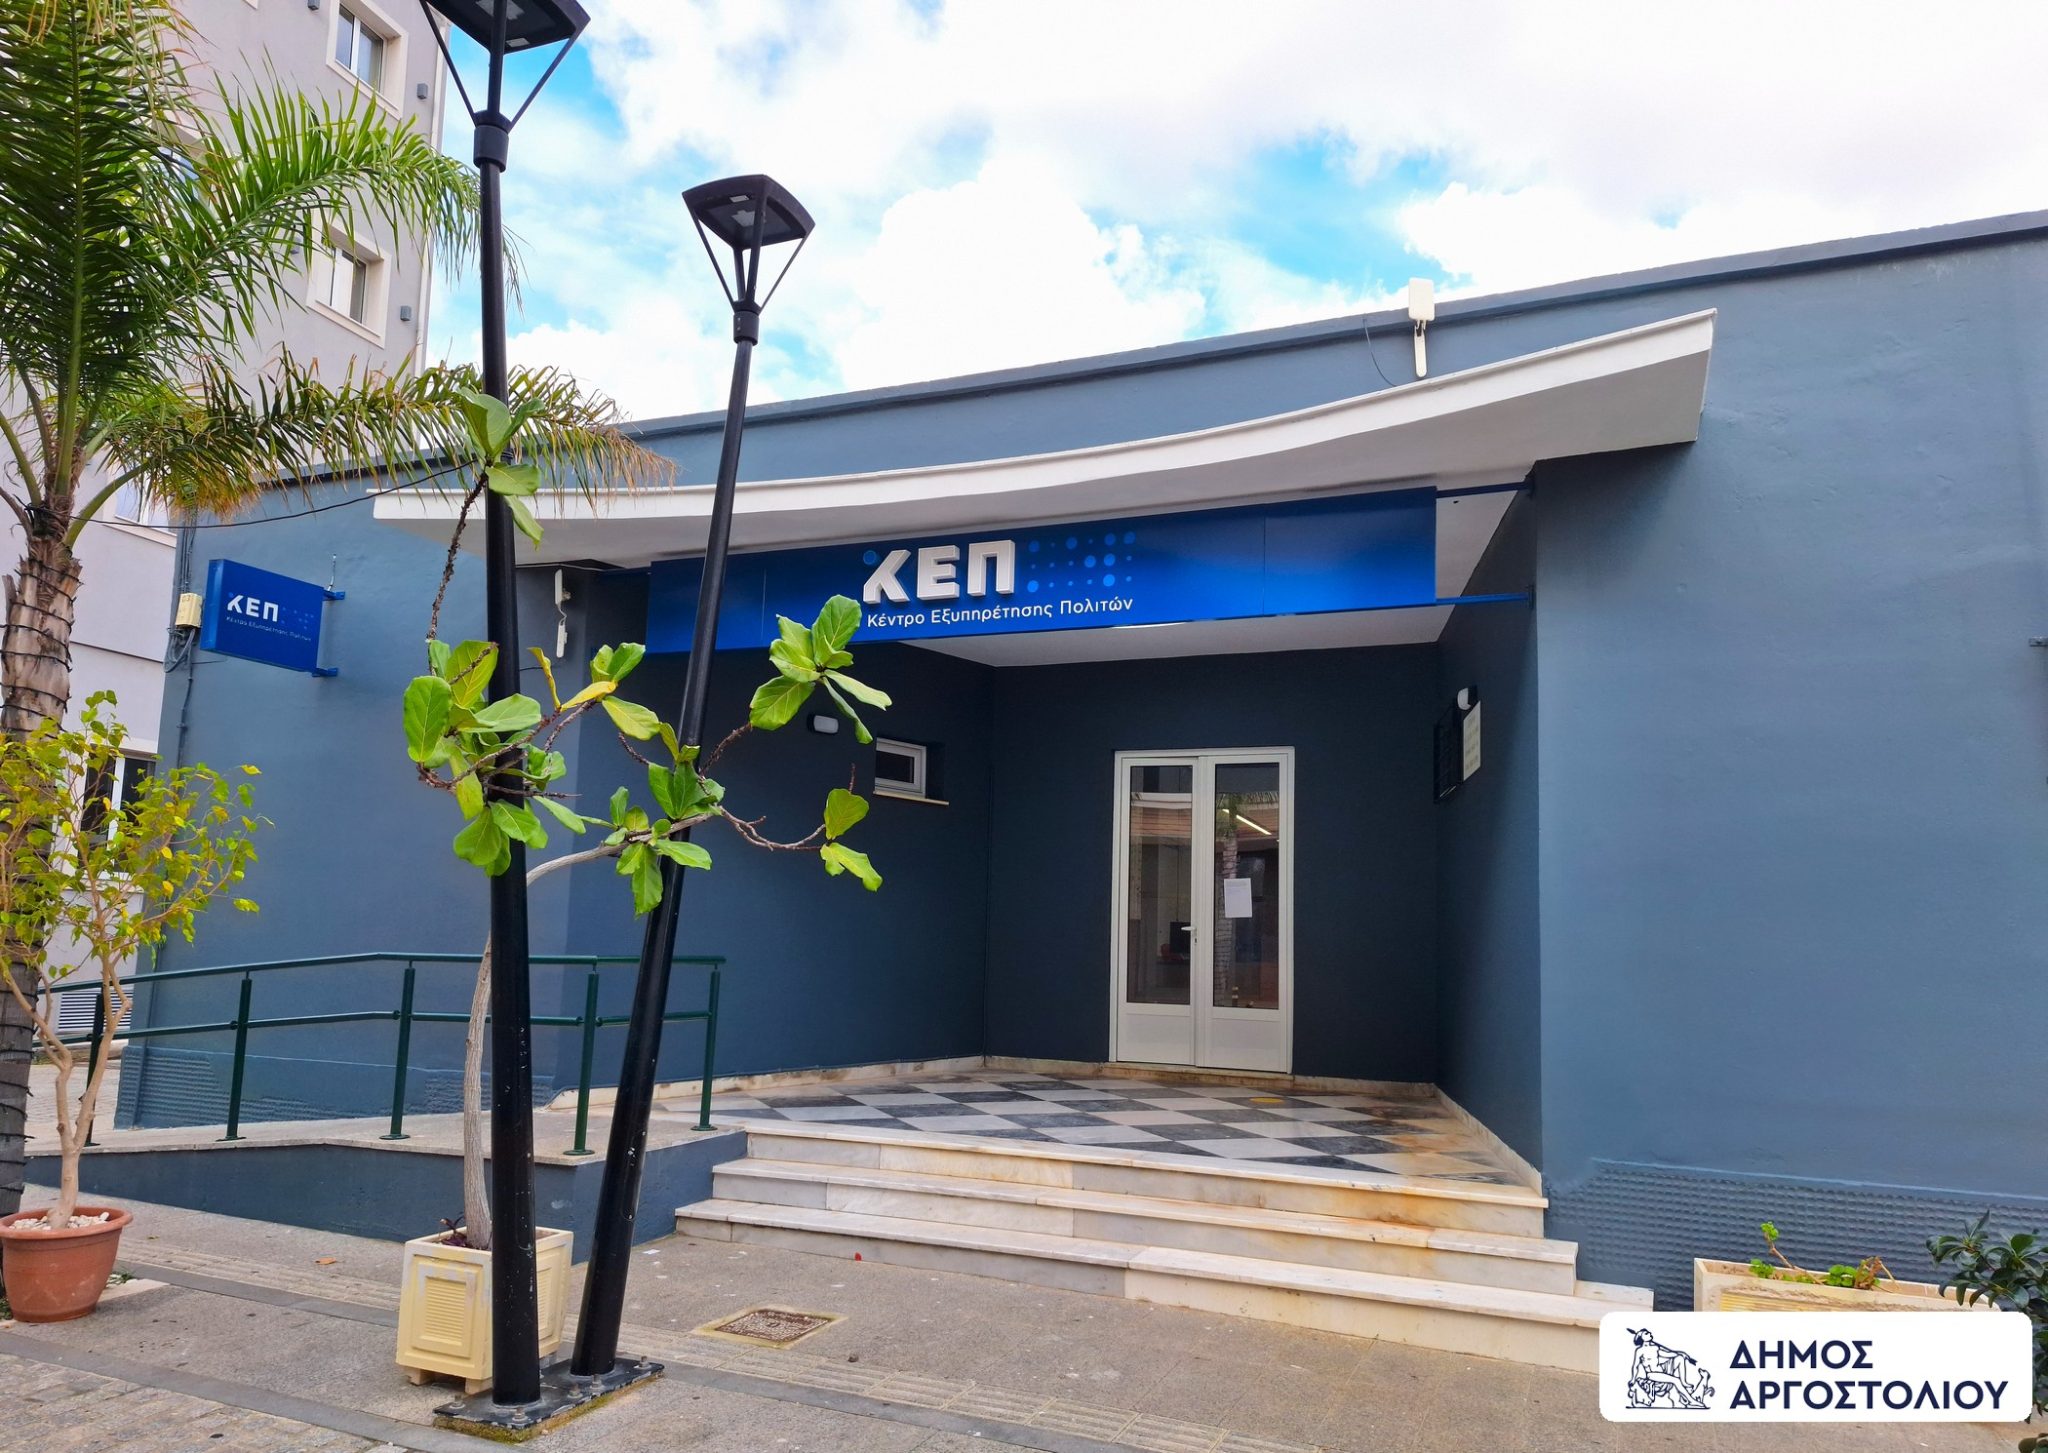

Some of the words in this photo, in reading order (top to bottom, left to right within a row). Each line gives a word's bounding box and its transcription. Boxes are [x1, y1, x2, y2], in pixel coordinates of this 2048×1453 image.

[862, 539, 1016, 604] ΚΕΠ
[227, 594, 279, 622] ΚΕΠ
[867, 612, 925, 628] Κέντρο
[931, 602, 1053, 624] Εξυπηρέτησης
[1060, 596, 1133, 615] Πολιτών
